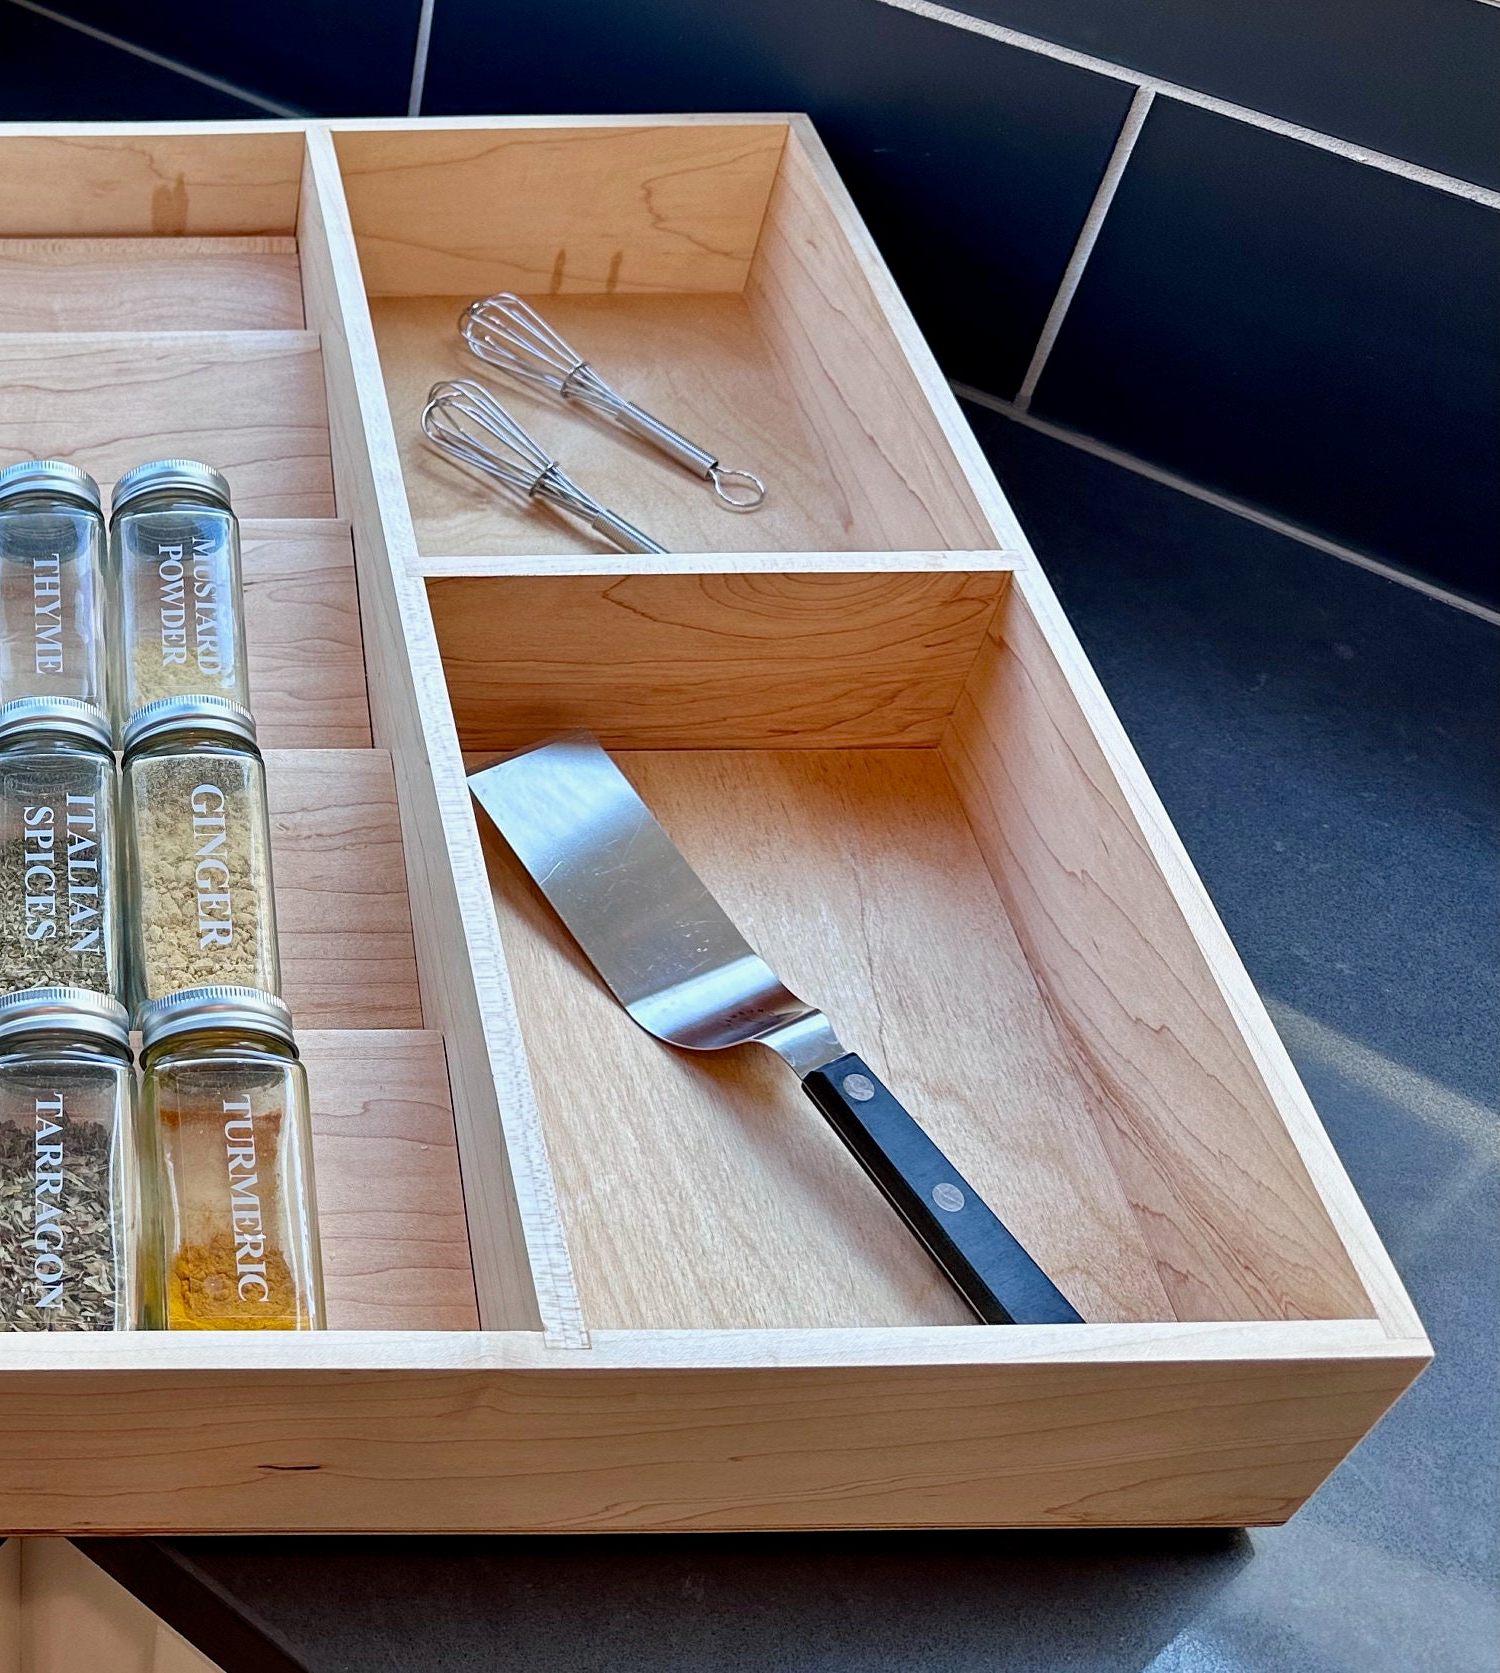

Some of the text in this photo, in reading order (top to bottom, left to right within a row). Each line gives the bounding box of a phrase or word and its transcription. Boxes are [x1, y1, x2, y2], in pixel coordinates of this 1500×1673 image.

[33, 553, 63, 674] THYME
[158, 543, 188, 667] POWDER
[191, 536, 222, 675] MUSTARD
[22, 805, 56, 941] SPICES
[65, 792, 101, 954] ITALIAN
[190, 783, 233, 949] GINGER
[34, 1092, 65, 1310] TARRAGON
[221, 1093, 270, 1303] TURMERIC
